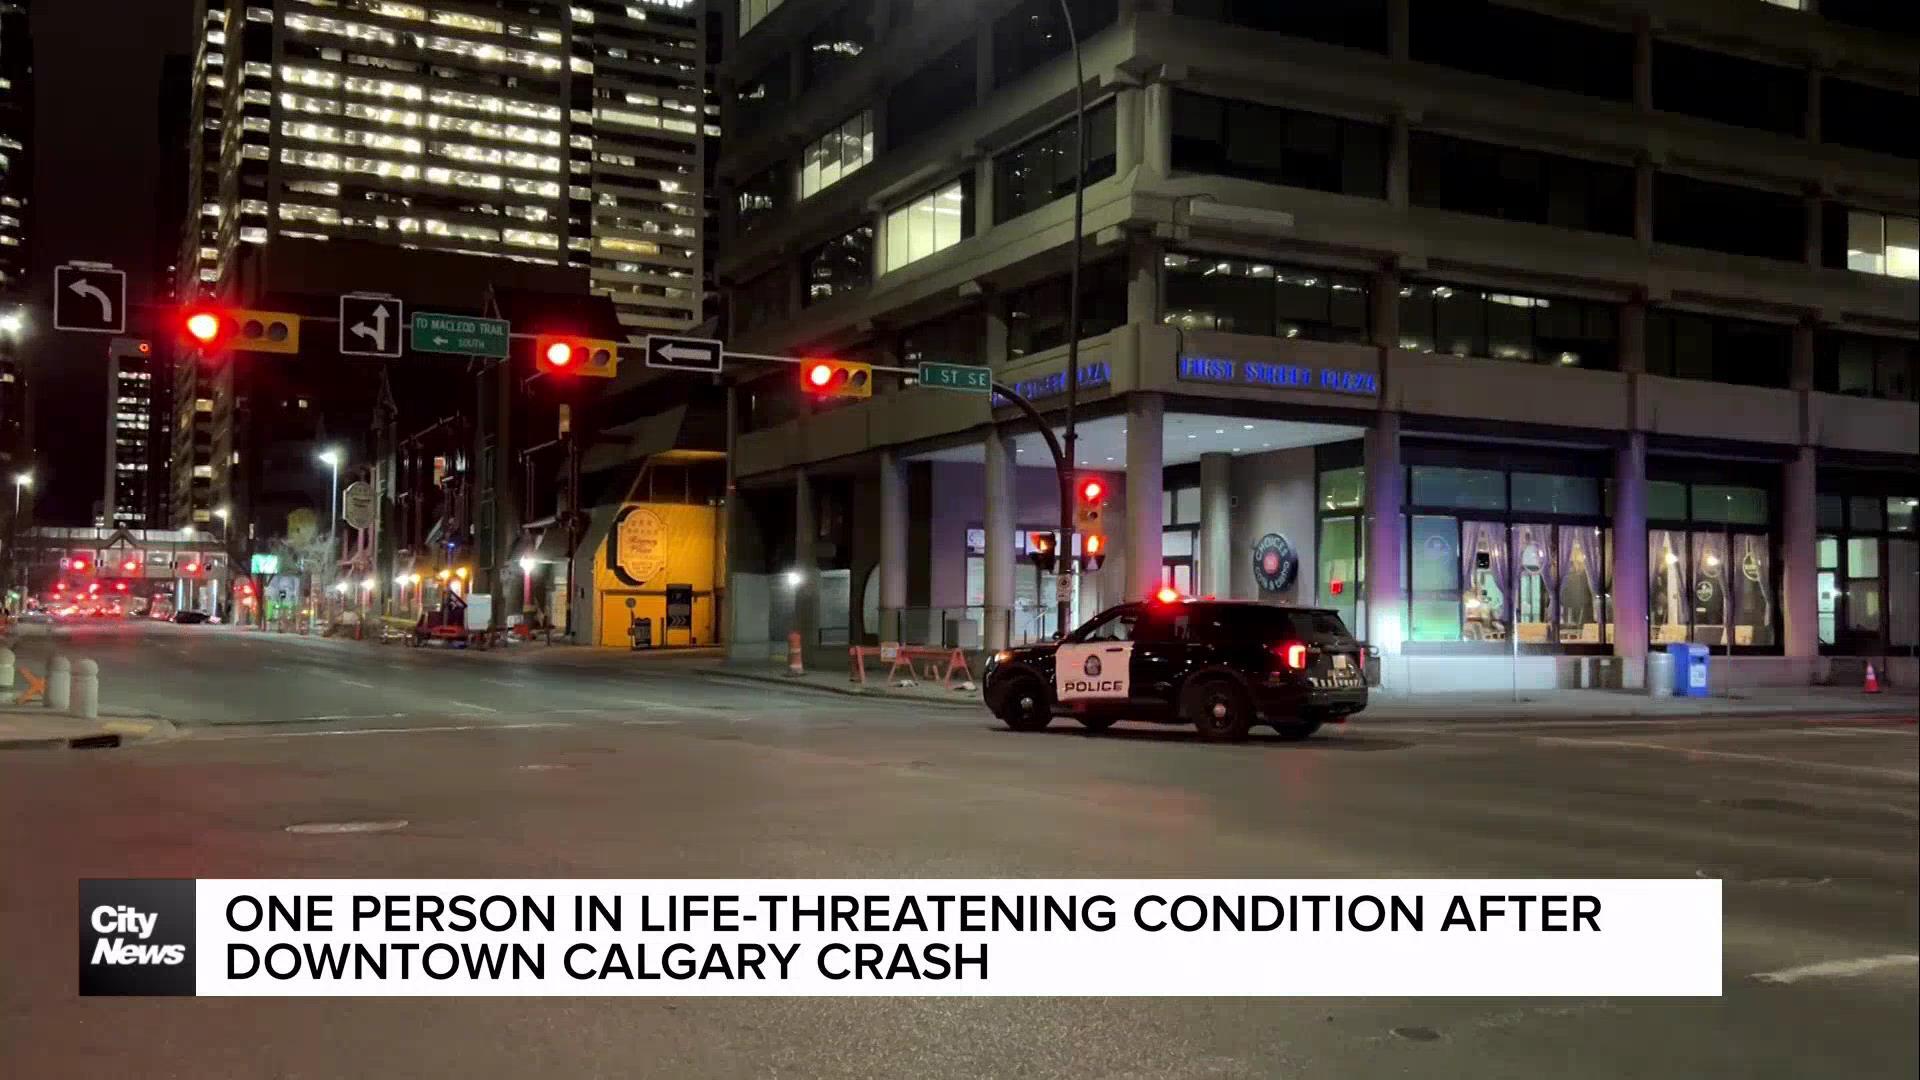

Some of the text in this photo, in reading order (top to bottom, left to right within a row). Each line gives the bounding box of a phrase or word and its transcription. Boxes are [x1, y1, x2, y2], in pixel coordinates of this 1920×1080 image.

[415, 317, 505, 336] TO MACLEOD TRAIL
[941, 369, 958, 384] ST
[968, 372, 987, 386] SE
[1180, 356, 1378, 393] FIRST STREET PLAZA
[1065, 681, 1123, 692] POLICE
